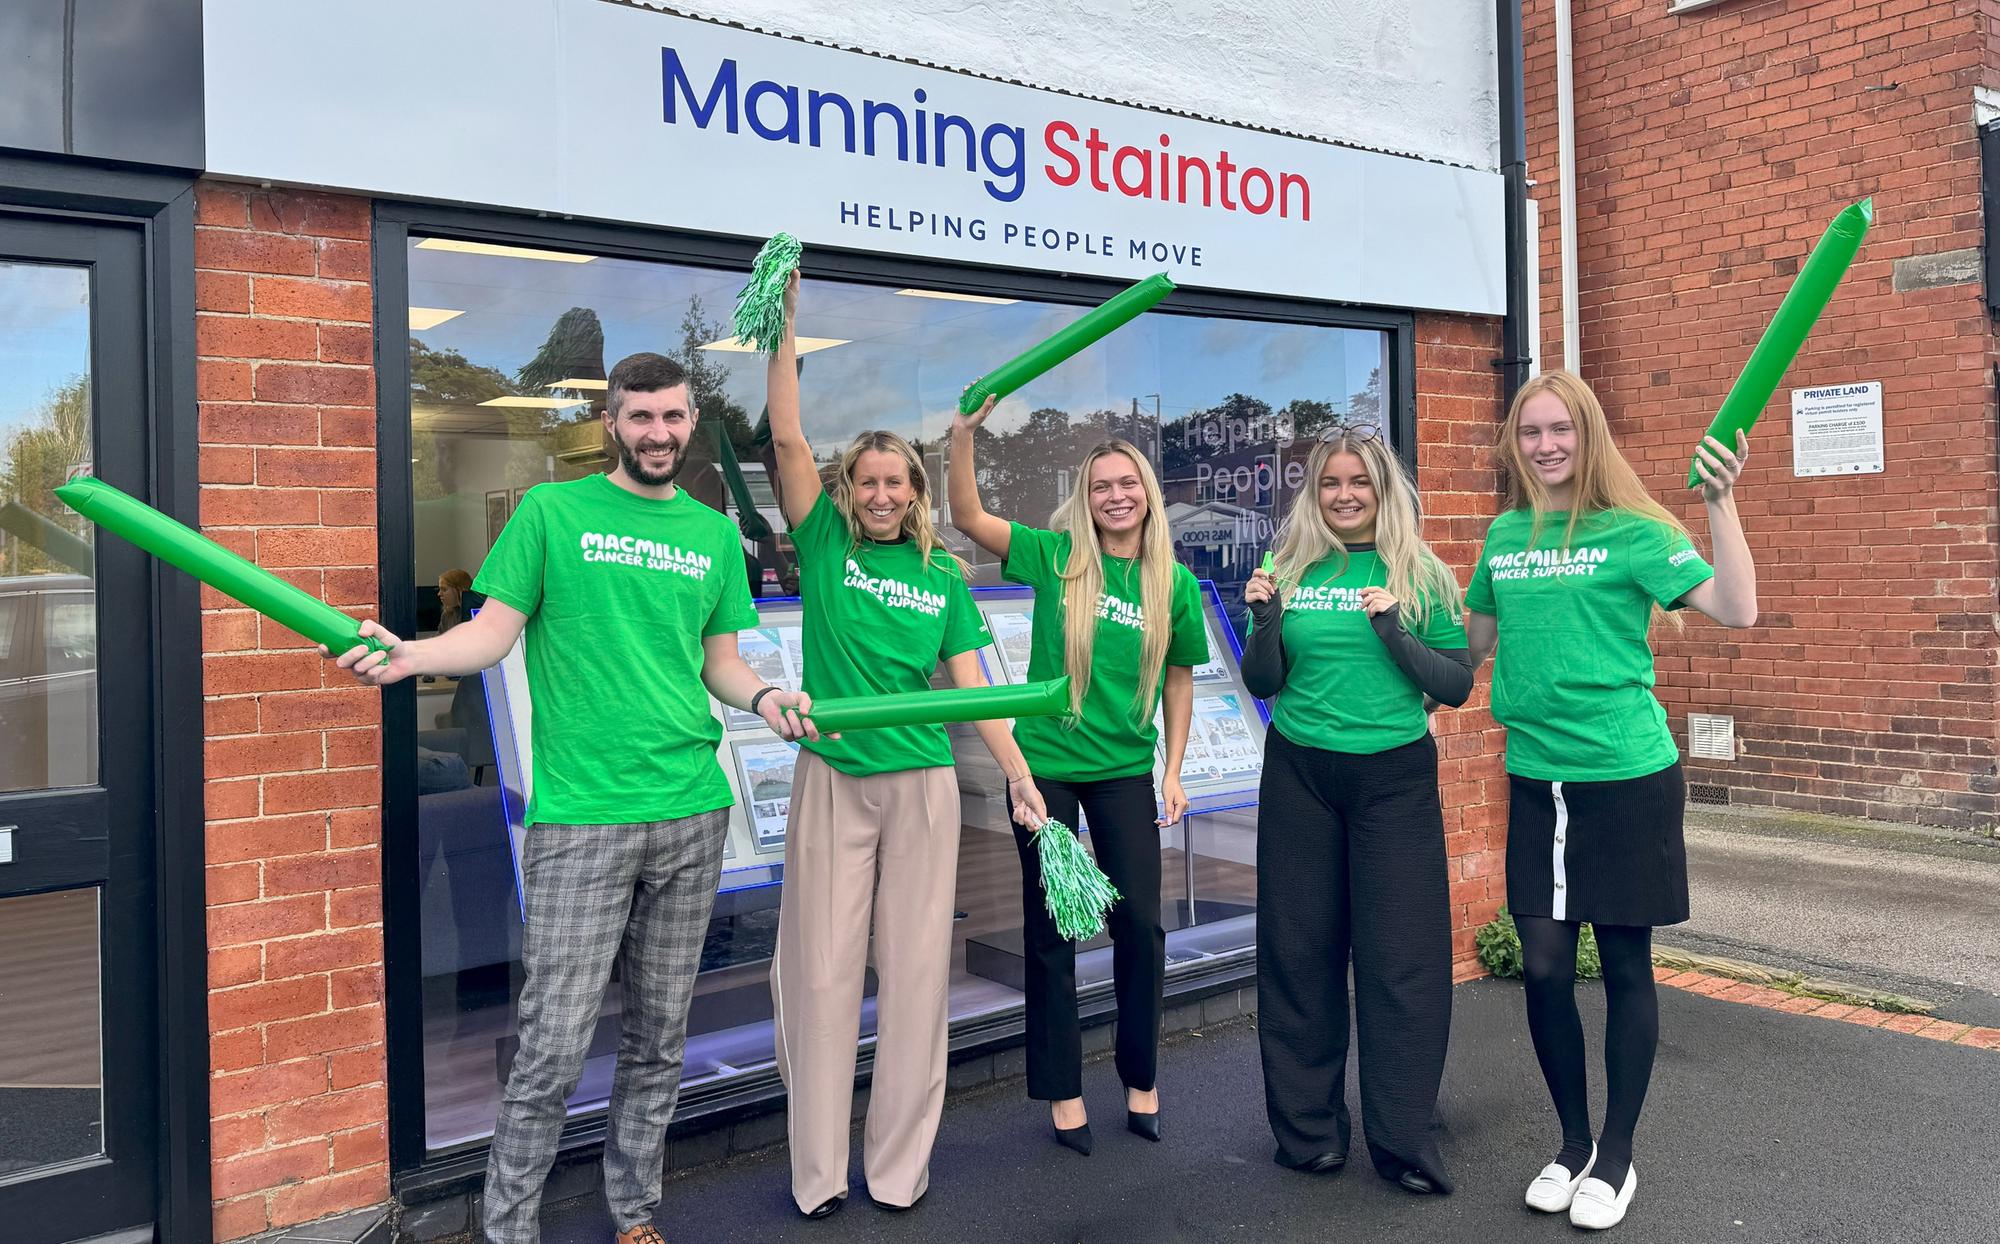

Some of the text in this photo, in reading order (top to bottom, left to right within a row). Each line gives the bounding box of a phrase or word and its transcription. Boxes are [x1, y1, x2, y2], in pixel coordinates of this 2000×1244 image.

[661, 46, 1310, 221] Manning Stainton
[840, 201, 1202, 267] HELPING PEOPLE MOVE
[1804, 388, 1841, 399] PRIVATE
[1843, 385, 1869, 395] LAND
[1184, 407, 1294, 453] Helping
[1196, 454, 1304, 503] People
[1235, 507, 1283, 549] Mov
[581, 532, 711, 571] MACMILLAN
[583, 550, 706, 581] CANCER SUPPORT
[1488, 547, 1608, 569] MACMILLAN
[1491, 563, 1598, 581] ANCER SUPPORT
[886, 595, 941, 618] SUPPORT
[1292, 586, 1364, 602] MACMIL
